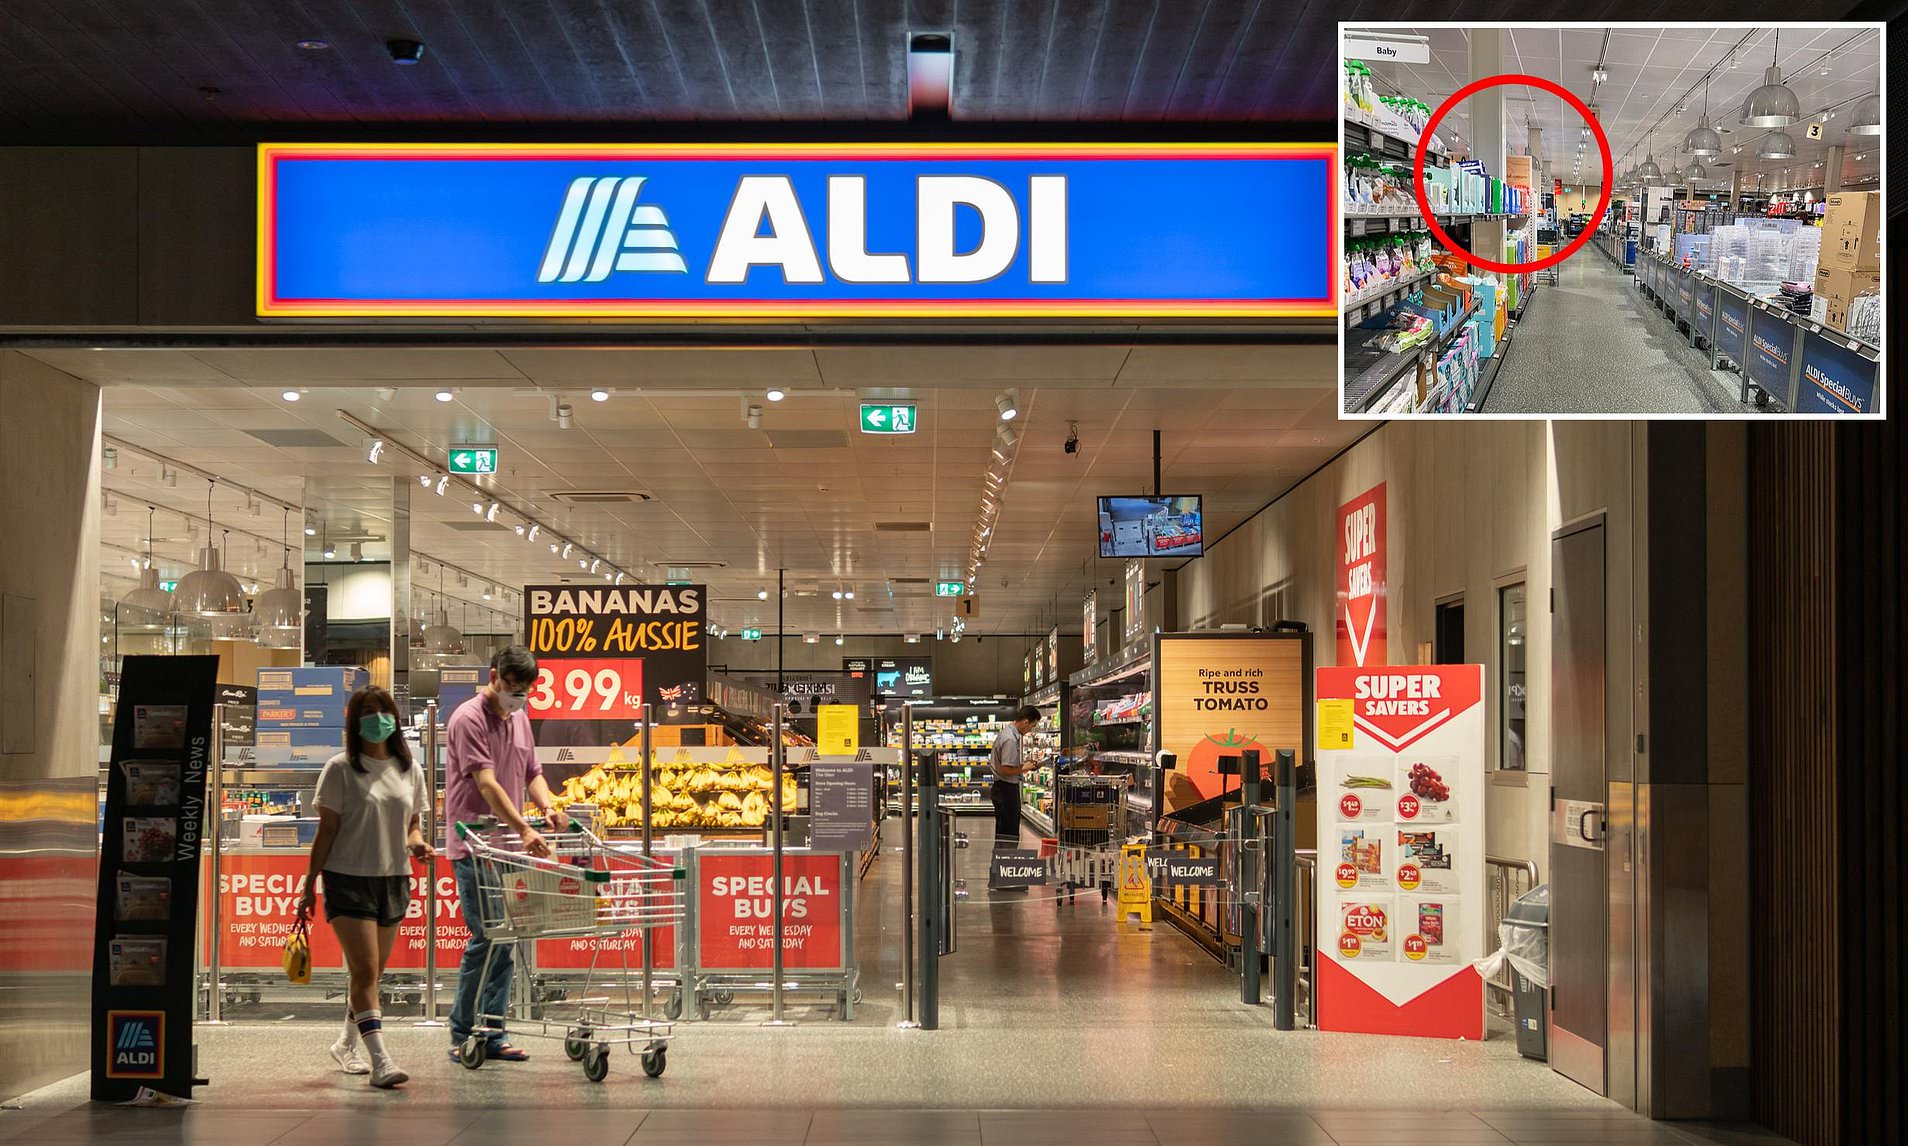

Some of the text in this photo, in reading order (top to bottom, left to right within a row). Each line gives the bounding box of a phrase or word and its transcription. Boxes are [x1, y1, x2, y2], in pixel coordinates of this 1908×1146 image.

[1377, 47, 1397, 57] Baby
[1811, 126, 1819, 136] 3
[706, 174, 1069, 285] ALDI
[1805, 364, 1820, 380] ALDI
[1344, 502, 1376, 565] SUPER
[1348, 561, 1372, 600] SAVERS
[530, 589, 699, 615] BANANAS
[963, 600, 971, 614] 1
[529, 617, 700, 652] 100% AUSSIE
[1199, 669, 1263, 679] Ripe and rich
[1202, 681, 1259, 694] TRUSS
[1354, 674, 1440, 699] SUPER
[624, 691, 641, 709] kg
[1194, 698, 1268, 711] TOMATO
[1365, 700, 1429, 716] SAVERS
[178, 736, 205, 861] Weekly News
[1000, 865, 1042, 877] WELCOME
[1171, 865, 1214, 877] WELCOME
[230, 922, 258, 933] EVERY
[1347, 916, 1383, 927] ETON
[400, 926, 427, 936] EVERY
[729, 925, 756, 936] EVERY
[239, 936, 256, 946] AND
[409, 938, 427, 949] AND
[570, 939, 587, 951] AND
[738, 938, 756, 949] AND
[116, 1052, 154, 1064] ALDI
